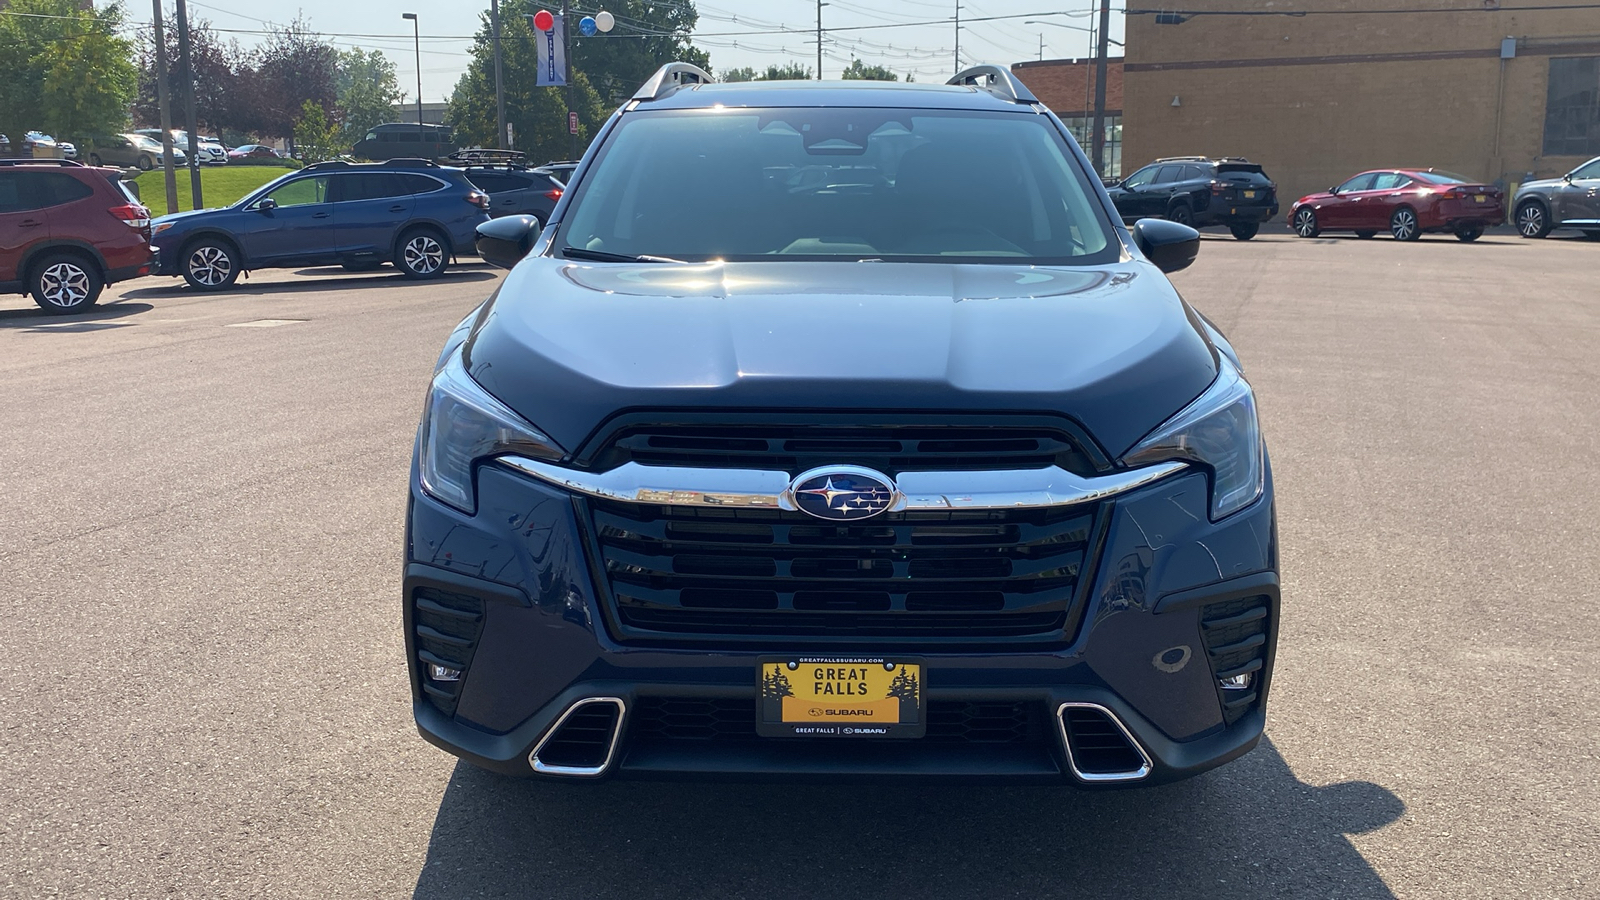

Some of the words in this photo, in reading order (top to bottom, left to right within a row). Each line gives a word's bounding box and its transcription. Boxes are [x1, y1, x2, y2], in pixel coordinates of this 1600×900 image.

[194, 153, 200, 166] 3
[814, 668, 868, 680] GREAT
[814, 682, 868, 695] FALLS
